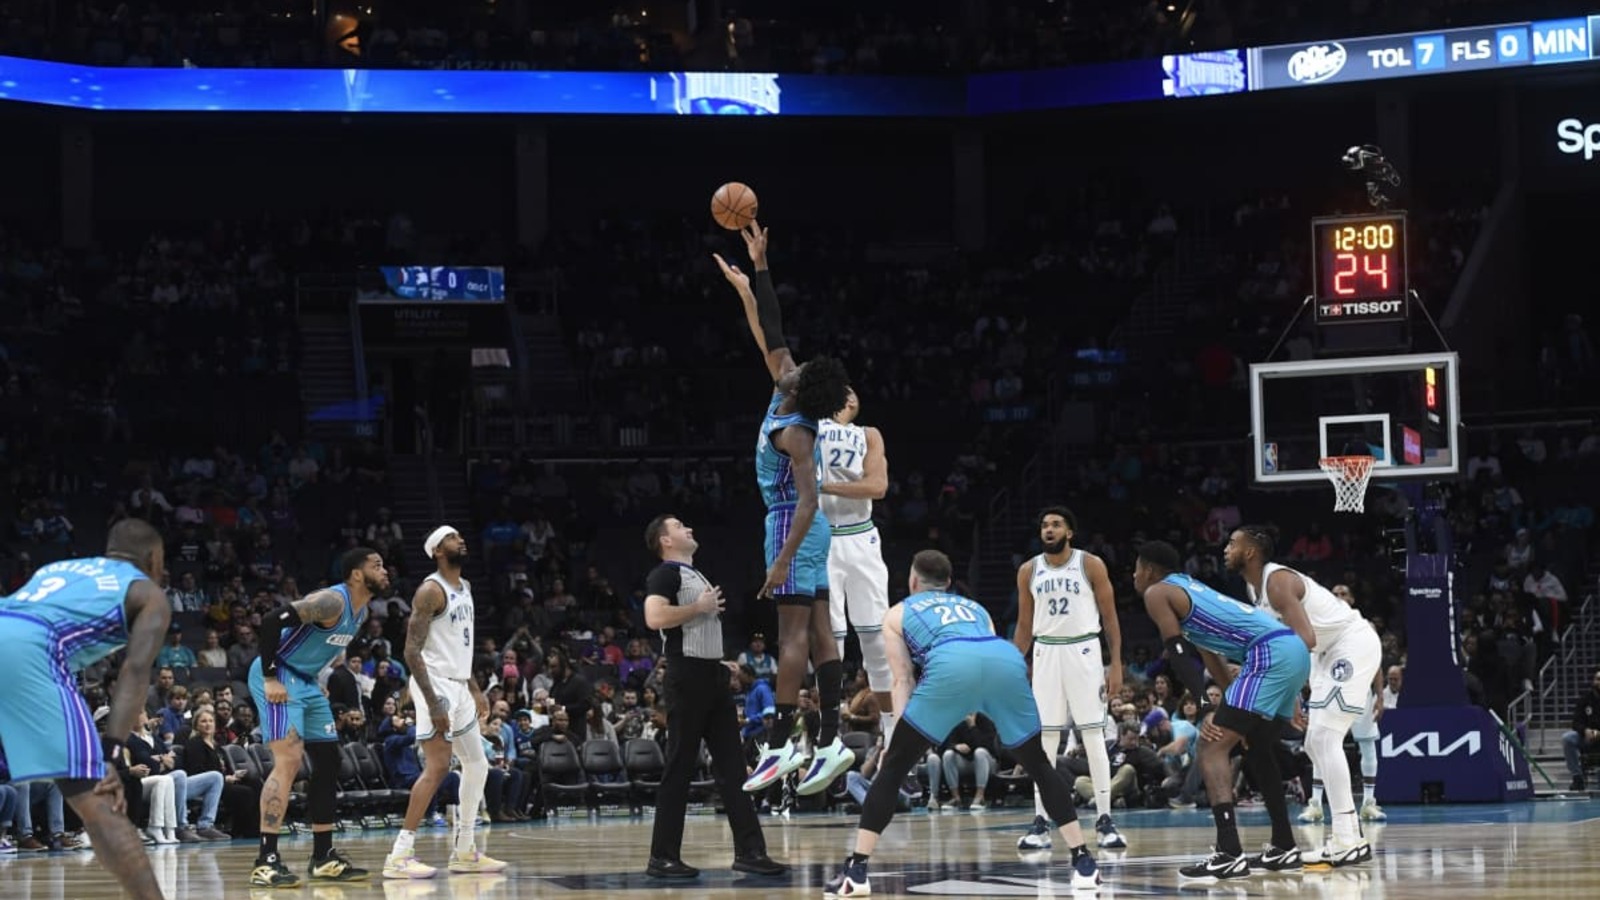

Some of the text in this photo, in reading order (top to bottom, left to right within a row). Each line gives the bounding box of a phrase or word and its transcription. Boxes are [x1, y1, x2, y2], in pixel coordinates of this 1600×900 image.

[1368, 35, 1518, 69] TOL 7 FLS 0
[1533, 28, 1585, 55] MIN
[1335, 224, 1394, 251] 12:00
[1335, 254, 1387, 294] 24
[1343, 300, 1402, 315] TISSOT
[819, 429, 865, 457] WOLVES
[830, 448, 855, 468] 27
[1036, 578, 1080, 595] WOLVES
[934, 604, 977, 625] 20
[1049, 597, 1069, 616] 32
[463, 627, 470, 647] 9
